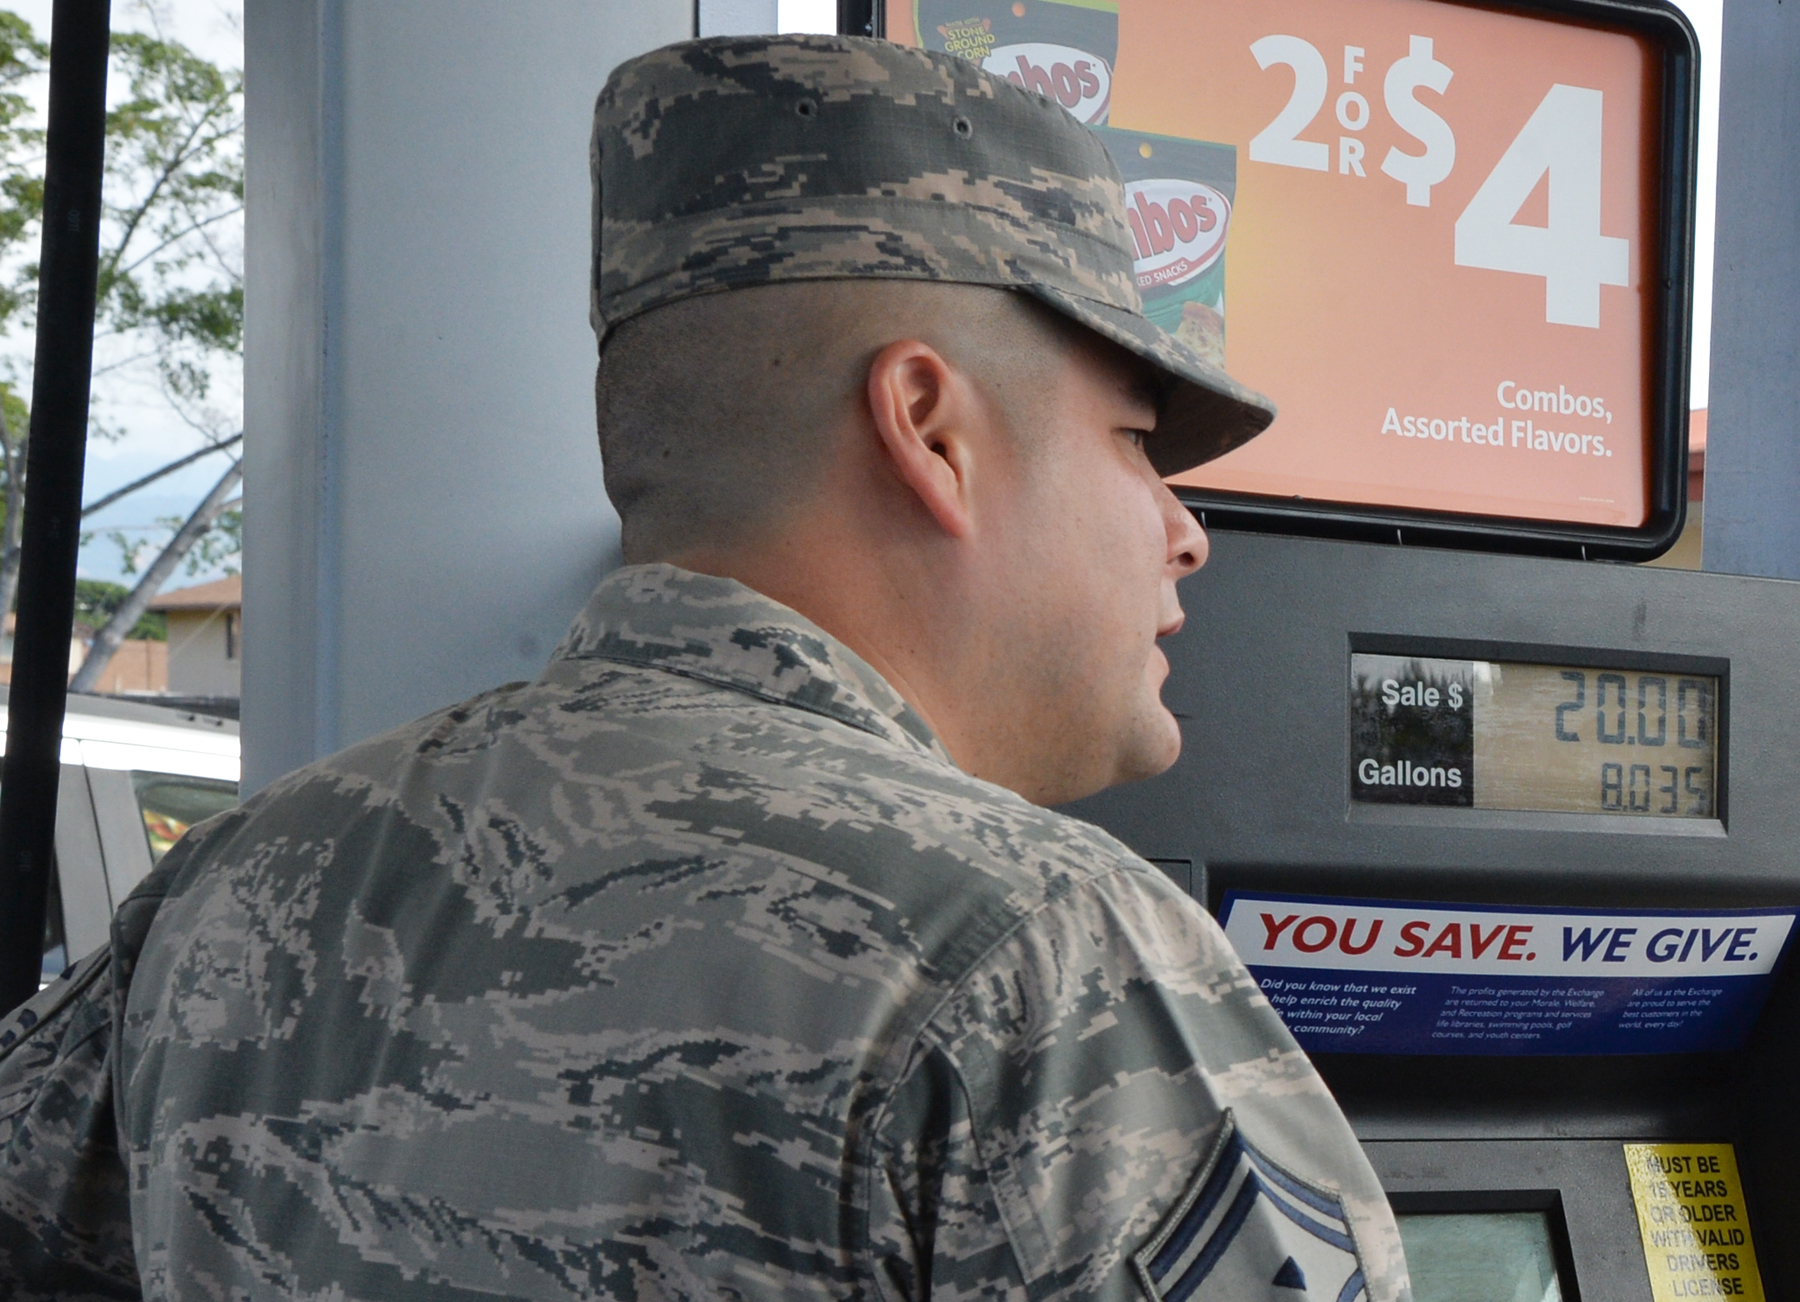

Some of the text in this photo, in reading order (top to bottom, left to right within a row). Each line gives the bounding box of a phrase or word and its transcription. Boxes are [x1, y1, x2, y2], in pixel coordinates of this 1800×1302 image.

[944, 33, 996, 52] GROUND
[947, 26, 986, 41] STONE
[957, 45, 992, 60] CORN
[1249, 34, 1329, 172] 2
[1336, 45, 1370, 178] FOR
[1154, 261, 1188, 283] SNACKS
[1497, 380, 1612, 424] Combos,
[1381, 407, 1612, 457] Assorted Flavors.
[1382, 670, 1706, 749] Sale $ 20.00
[1358, 758, 1462, 788] Gallons
[1260, 913, 1758, 963] YOU SAVE. WE GIVE.
[1260, 978, 1417, 995] Did you know that we exist
[1451, 986, 1466, 995] The
[1468, 987, 1495, 996] profits
[1497, 988, 1539, 997] generated
[1540, 988, 1550, 997] by
[1567, 988, 1605, 998] Exchange
[1687, 988, 1723, 997] Exchange
[1271, 994, 1402, 1010] help enrich the quality
[1461, 999, 1498, 1007] returned
[1499, 999, 1508, 1007] to
[1510, 1000, 1529, 1008] your
[1287, 1009, 1323, 1019] within
[1324, 1013, 1351, 1022] your
[1354, 1011, 1383, 1022] local
[1440, 1008, 1457, 1017] and
[1458, 1008, 1501, 1017] Recreation
[1503, 1011, 1543, 1019] programs
[1544, 1010, 1559, 1018] and
[1293, 1025, 1365, 1037] community?
[1487, 1021, 1529, 1030] swimming
[1555, 1021, 1573, 1030] golf
[1468, 1031, 1484, 1039] and
[1484, 1032, 1508, 1040] youth
[1647, 1156, 1721, 1174] MUST BE
[1669, 1180, 1728, 1198] YEARS
[1650, 1204, 1738, 1223] OR OLDER
[1650, 1228, 1745, 1248] WITH VALID
[1666, 1253, 1740, 1272] DRIVERS
[1672, 1277, 1744, 1297] LICENSE
